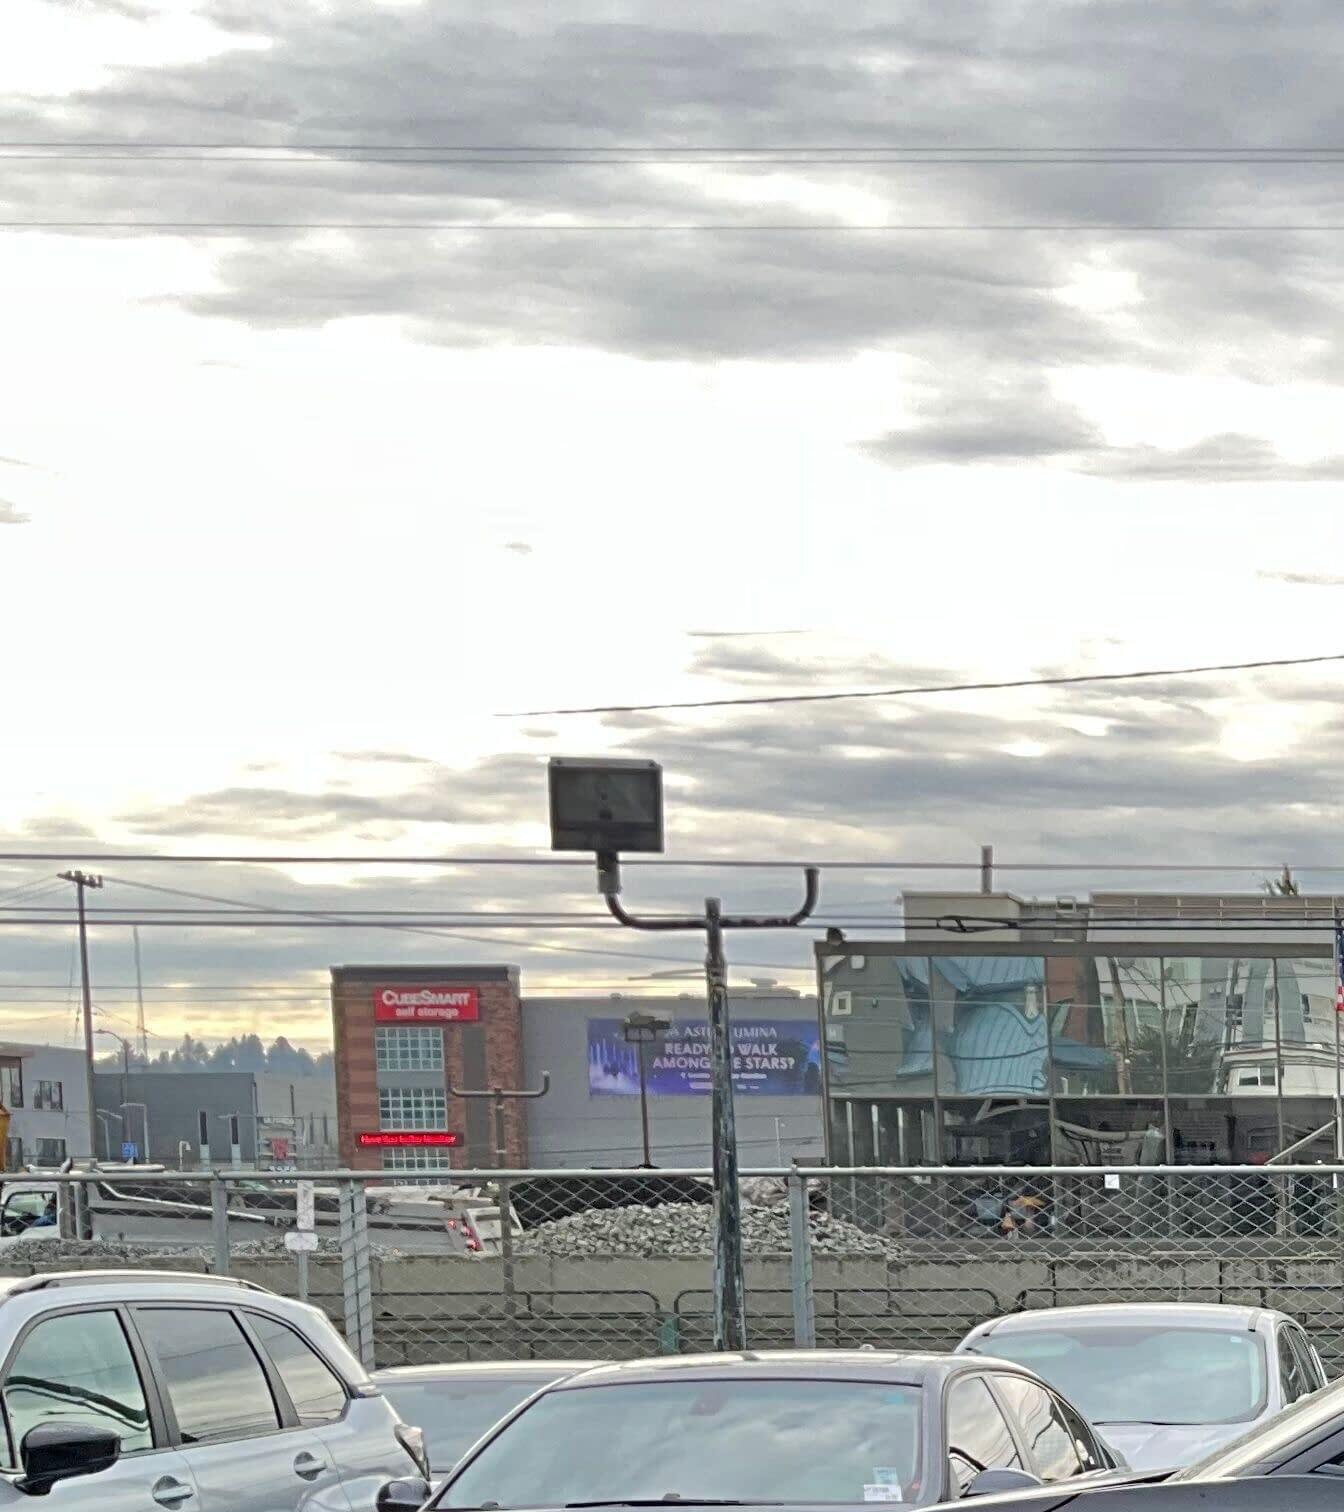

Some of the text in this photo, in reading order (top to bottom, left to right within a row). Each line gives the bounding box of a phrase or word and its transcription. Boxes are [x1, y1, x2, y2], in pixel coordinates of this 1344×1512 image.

[395, 1006, 459, 1019] self storage
[664, 1043, 711, 1055] READY
[738, 1043, 778, 1055] WALK
[652, 1057, 711, 1069] AMONG
[746, 1057, 796, 1069] STARS?
